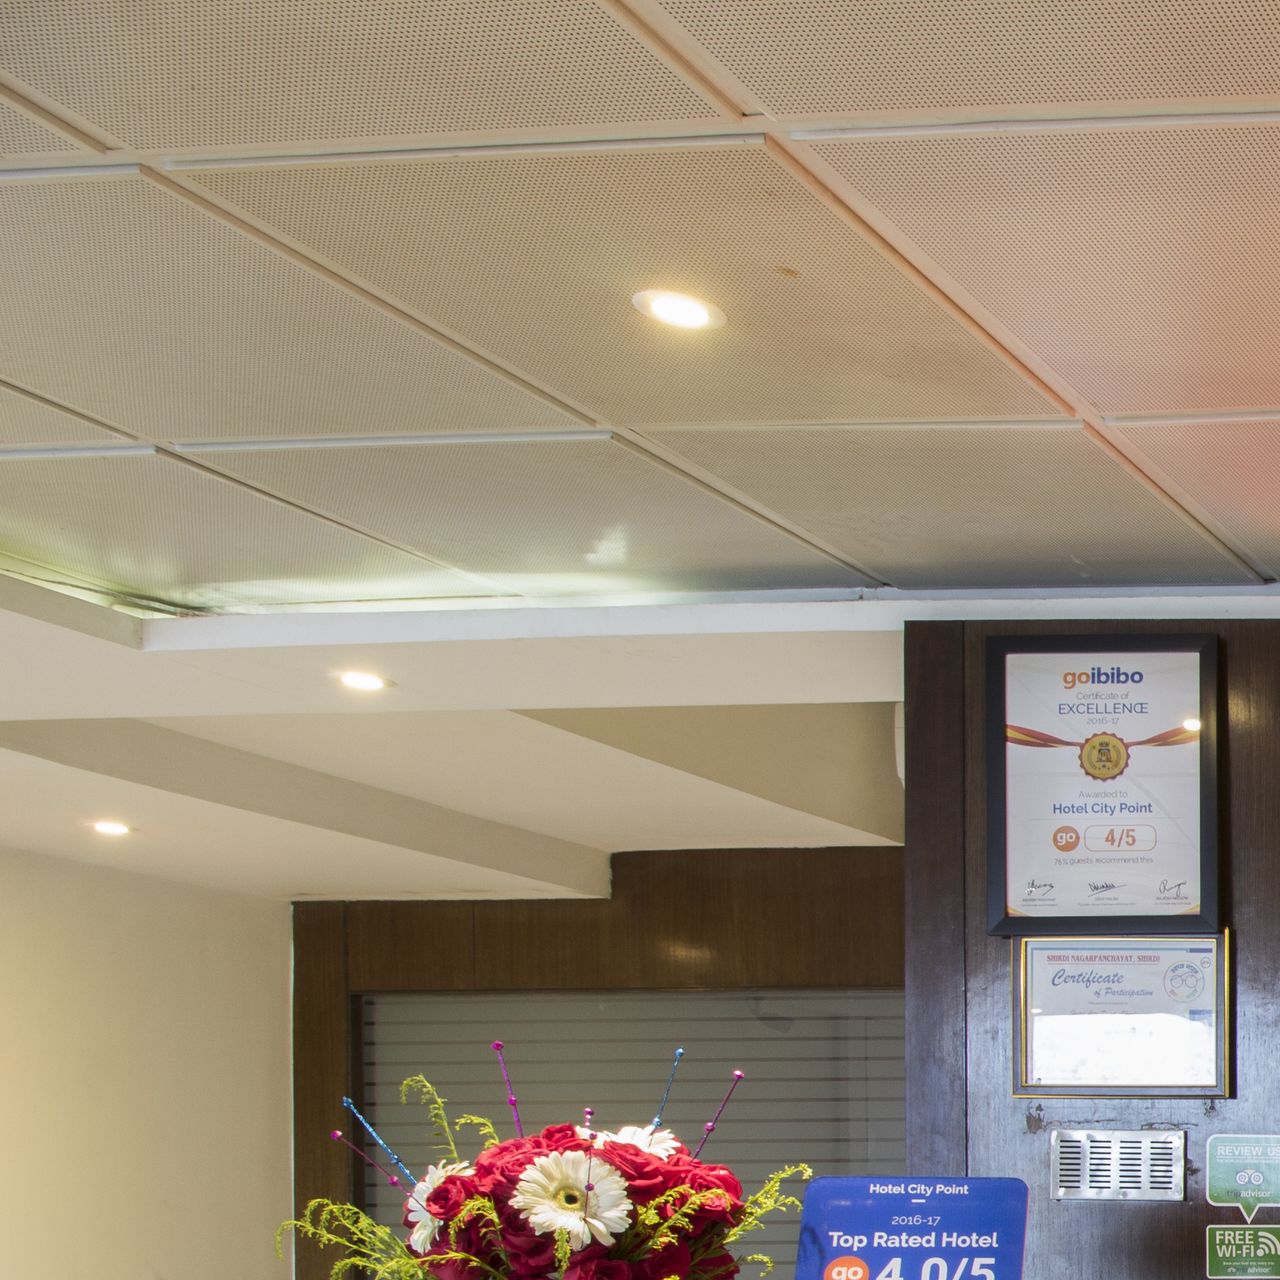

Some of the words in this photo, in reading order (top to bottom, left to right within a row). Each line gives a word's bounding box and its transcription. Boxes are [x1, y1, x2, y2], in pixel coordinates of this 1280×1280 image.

[1062, 666, 1144, 690] goibibo
[1076, 692, 1119, 701] Certificate
[1120, 692, 1129, 700] of
[1058, 702, 1149, 715] EXCELLENCE
[1086, 717, 1120, 725] 2016-17
[1078, 790, 1118, 799] Awarded
[1119, 790, 1129, 799] to
[1052, 803, 1089, 814] Hotel
[1091, 802, 1117, 816] City
[1119, 802, 1153, 814] Point
[1056, 832, 1076, 846] go
[1104, 828, 1137, 848] 4/5
[1069, 858, 1093, 866] guests
[1095, 857, 1139, 865] recommend
[1139, 856, 1154, 864] this
[1051, 968, 1124, 988] Certificate
[1094, 989, 1101, 999] of
[1104, 987, 1154, 998] Participation
[1216, 1146, 1262, 1156] REVIEW
[869, 1184, 905, 1194] Hotel
[907, 1184, 933, 1196] City
[936, 1184, 969, 1195] Point
[891, 1215, 941, 1226] 2016-17
[828, 1232, 868, 1251] Top
[873, 1232, 936, 1248] Rated
[941, 1232, 999, 1248] Hotel
[1215, 1231, 1254, 1244] FREE
[1216, 1245, 1255, 1257] WI-FI
